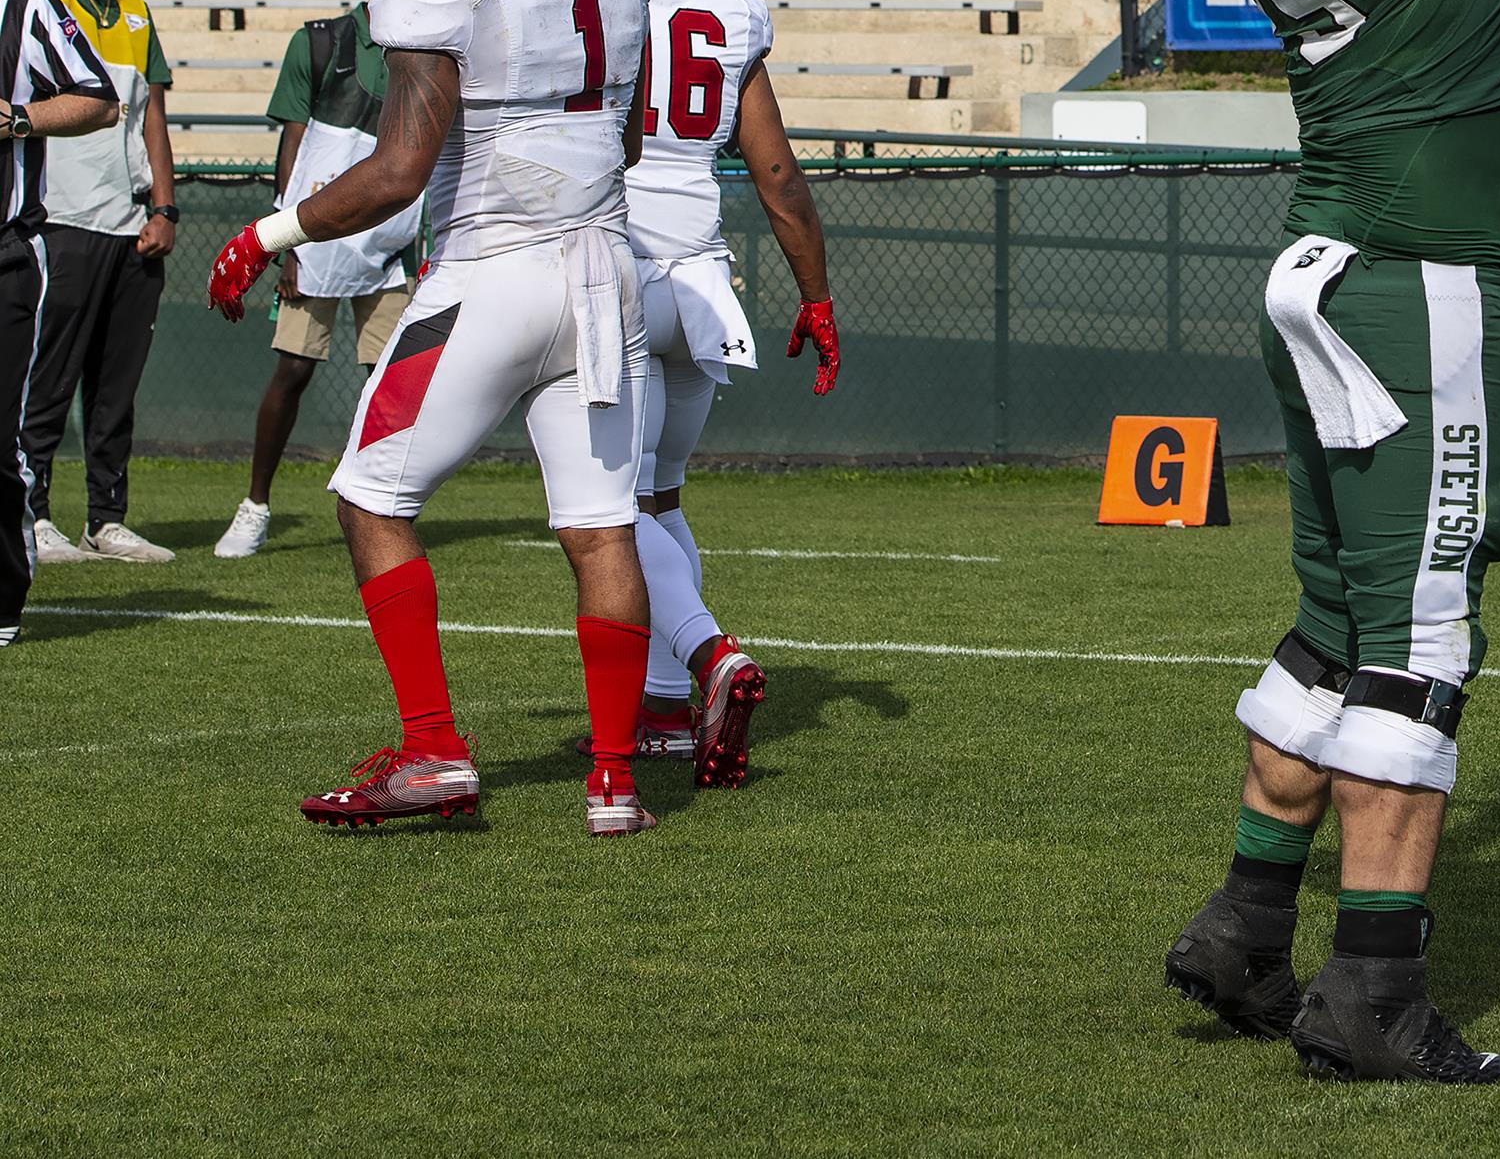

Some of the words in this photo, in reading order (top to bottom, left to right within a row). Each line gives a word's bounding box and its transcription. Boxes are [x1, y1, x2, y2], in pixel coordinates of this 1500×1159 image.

[1020, 43, 1035, 65] D
[1134, 426, 1186, 508] G
[1428, 424, 1480, 574] STETSON
